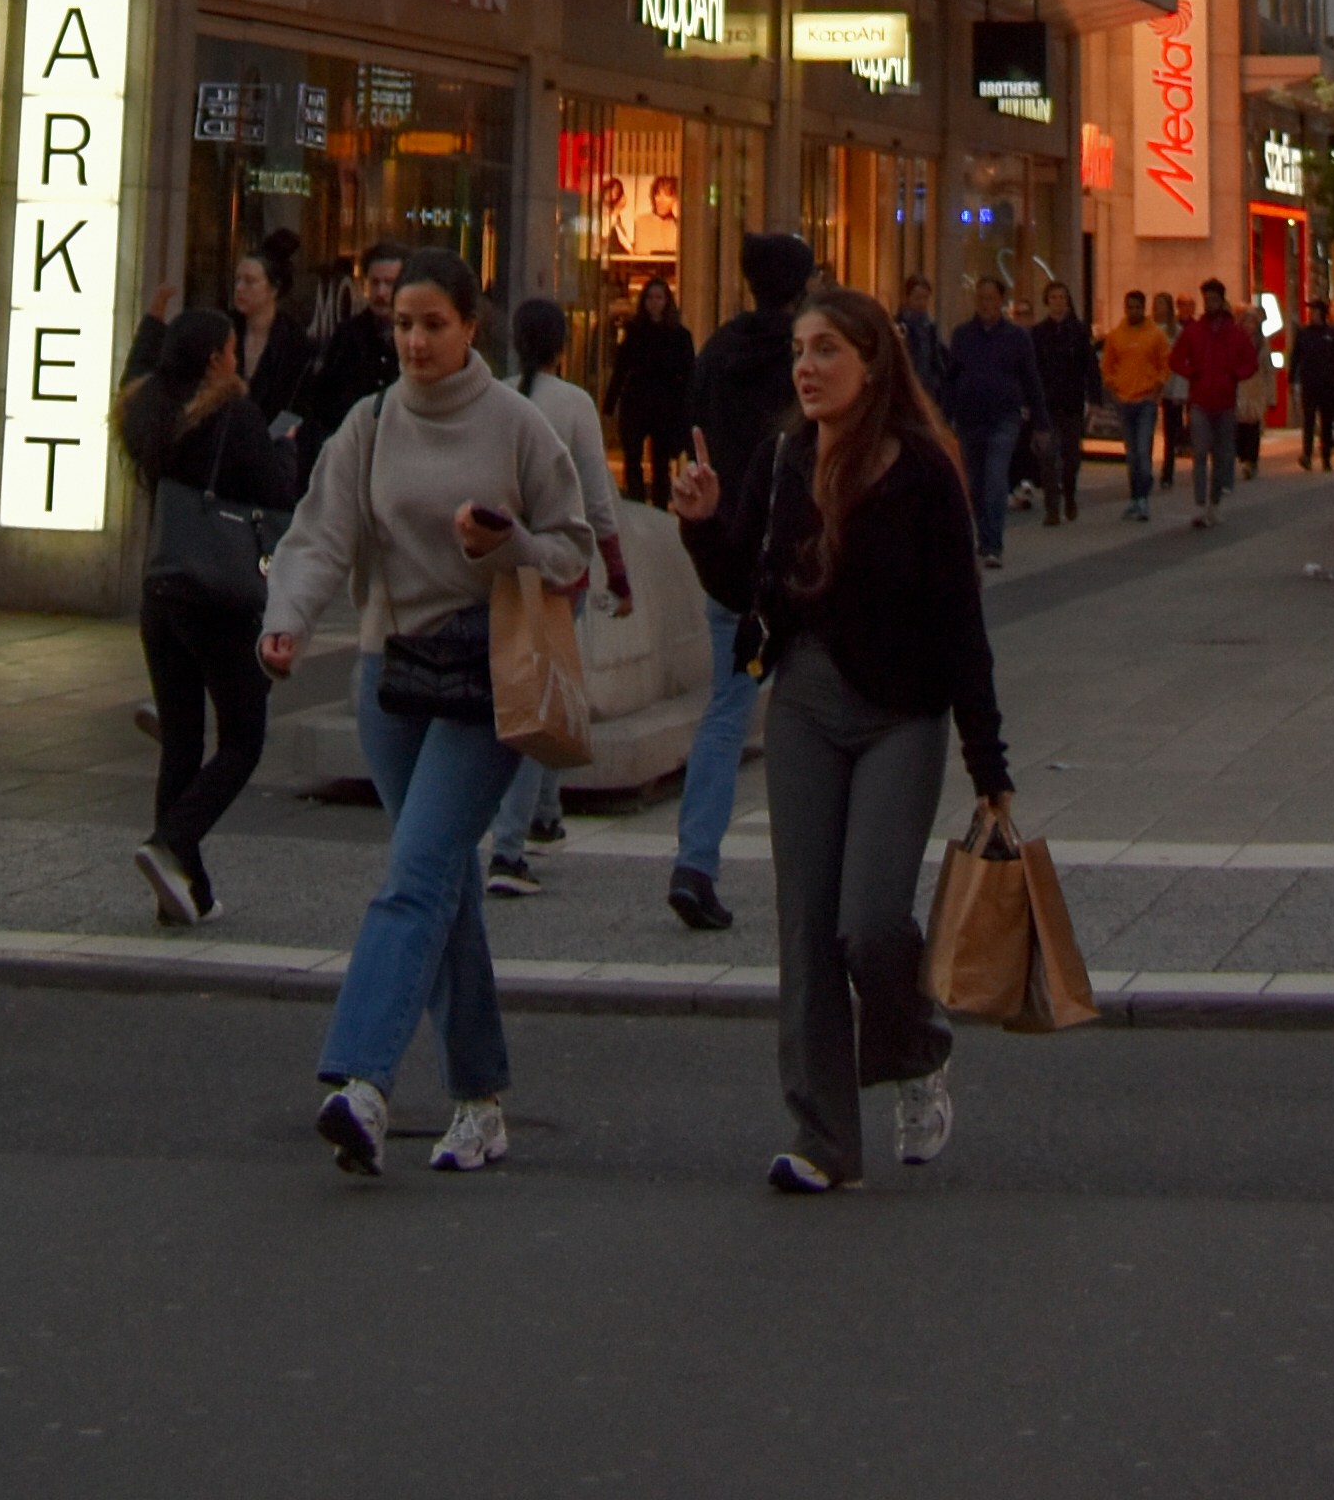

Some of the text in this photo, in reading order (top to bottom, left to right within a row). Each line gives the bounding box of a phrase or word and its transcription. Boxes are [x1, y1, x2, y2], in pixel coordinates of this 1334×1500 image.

[807, 26, 886, 47] KappAhl
[978, 80, 1041, 98] BROTHERS
[1143, 35, 1195, 216] Media
[23, 6, 101, 513] ARKET
